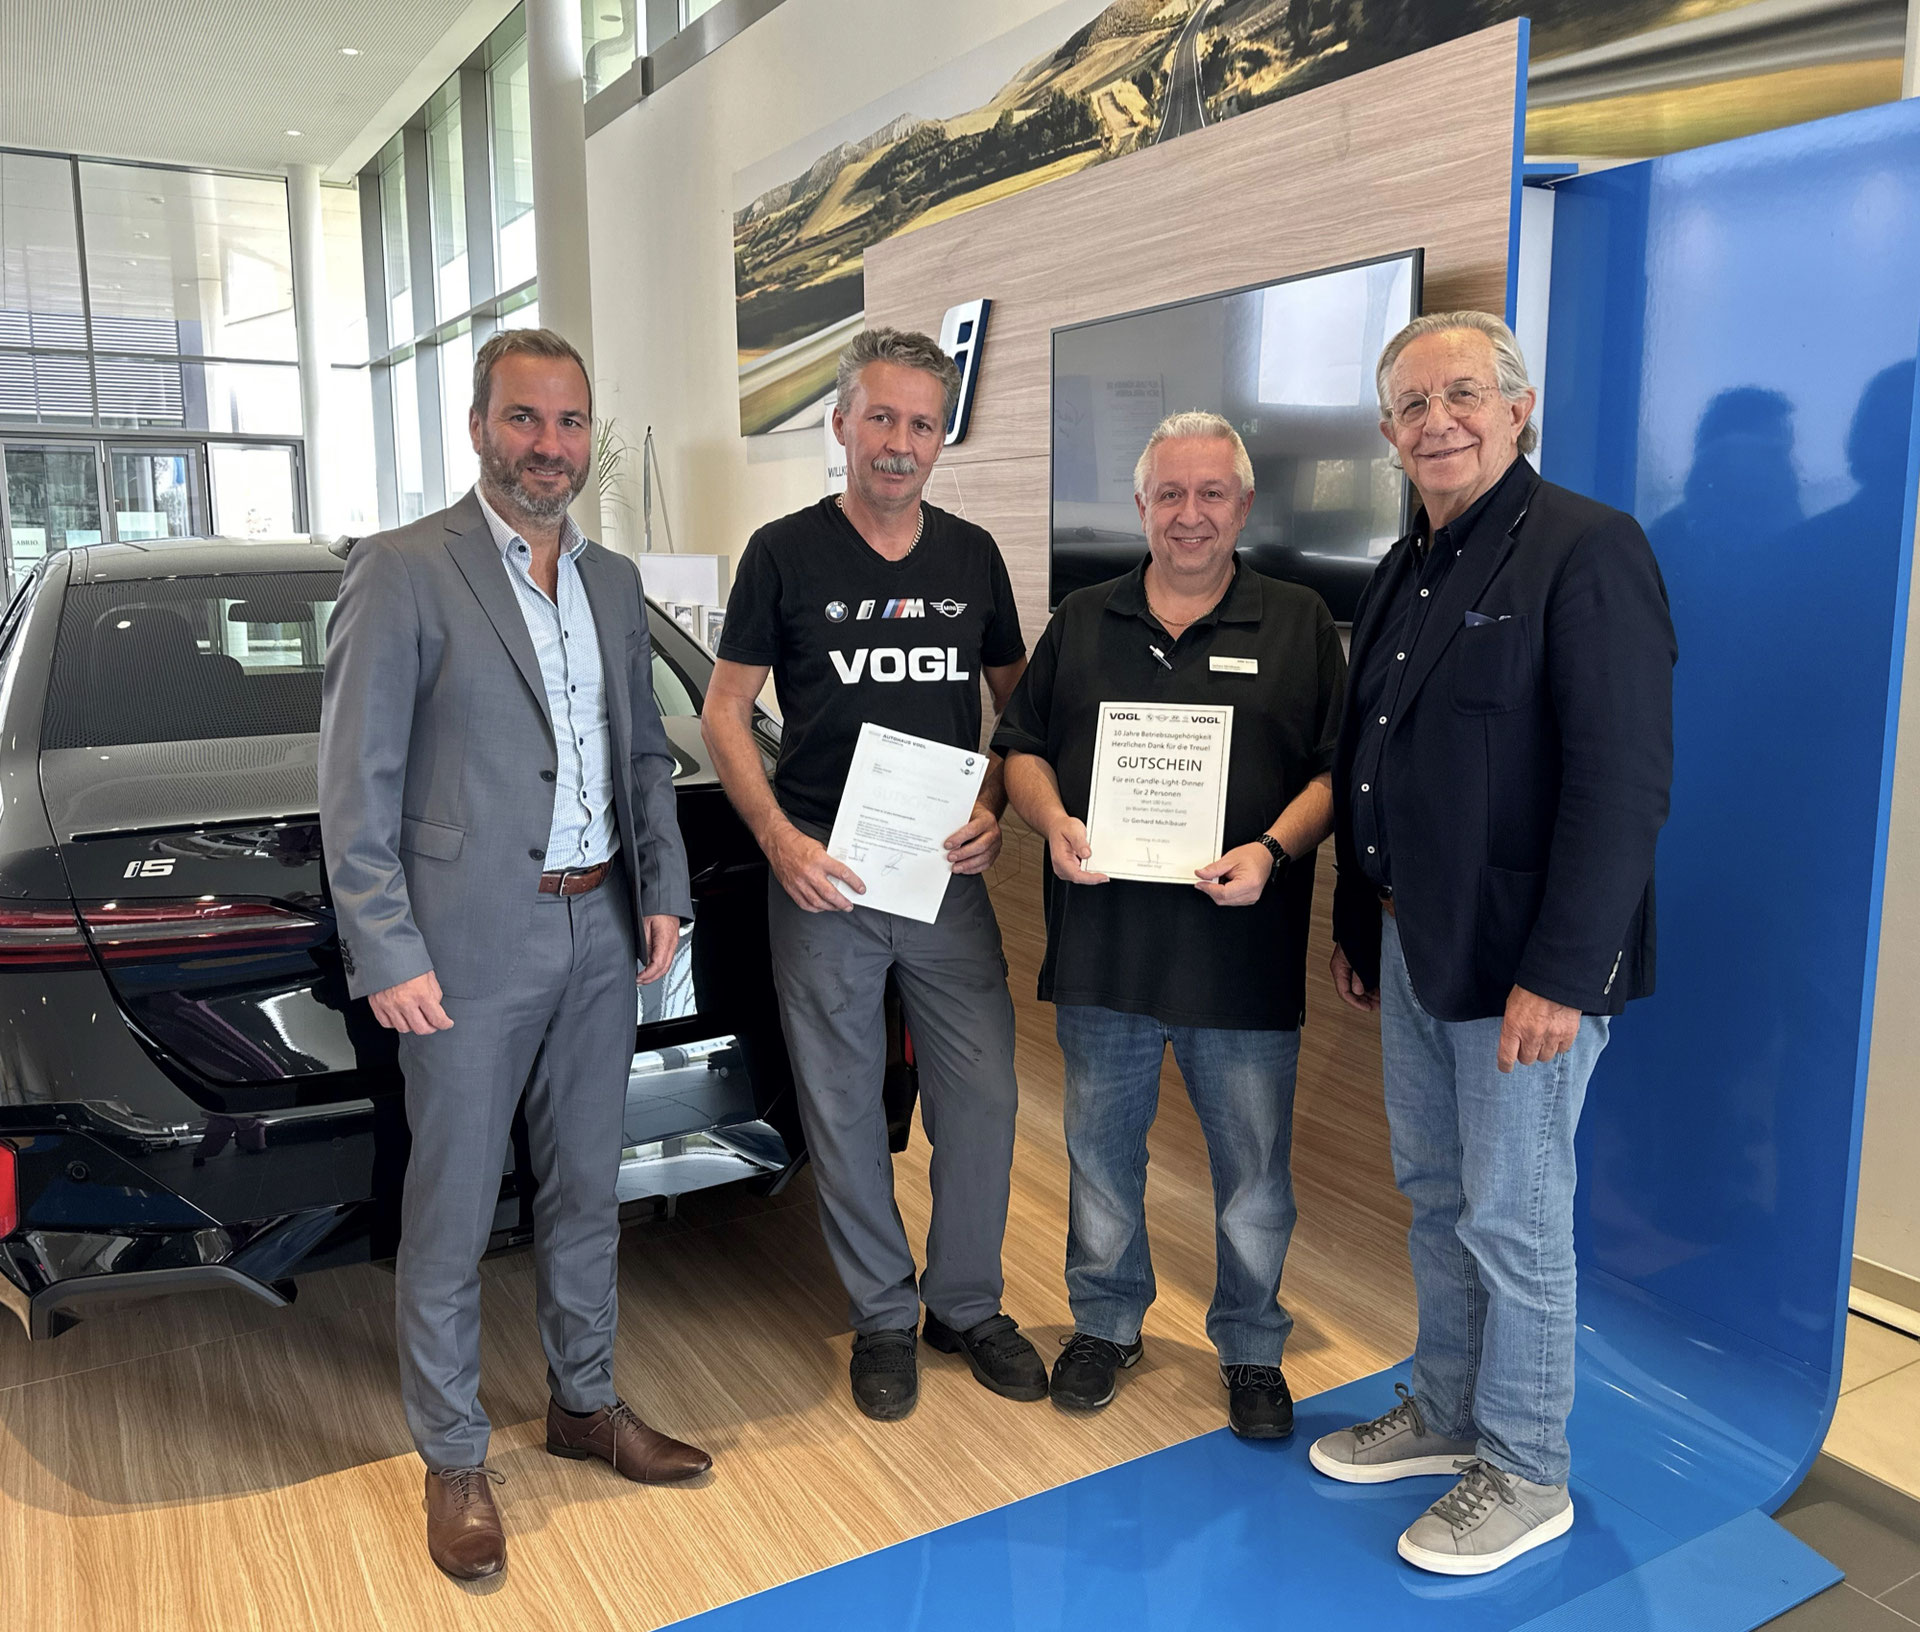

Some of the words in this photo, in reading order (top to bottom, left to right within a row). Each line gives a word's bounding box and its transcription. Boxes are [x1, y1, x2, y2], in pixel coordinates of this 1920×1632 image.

[828, 647, 969, 684] VOGL
[1109, 713, 1141, 721] VOGL
[1191, 716, 1221, 724] VOGL
[1141, 731, 1212, 740] Betriebszugehörigkeit
[1117, 756, 1202, 772] GUTSCHEIN
[1150, 789, 1182, 797] Personen
[123, 858, 176, 878] i5
